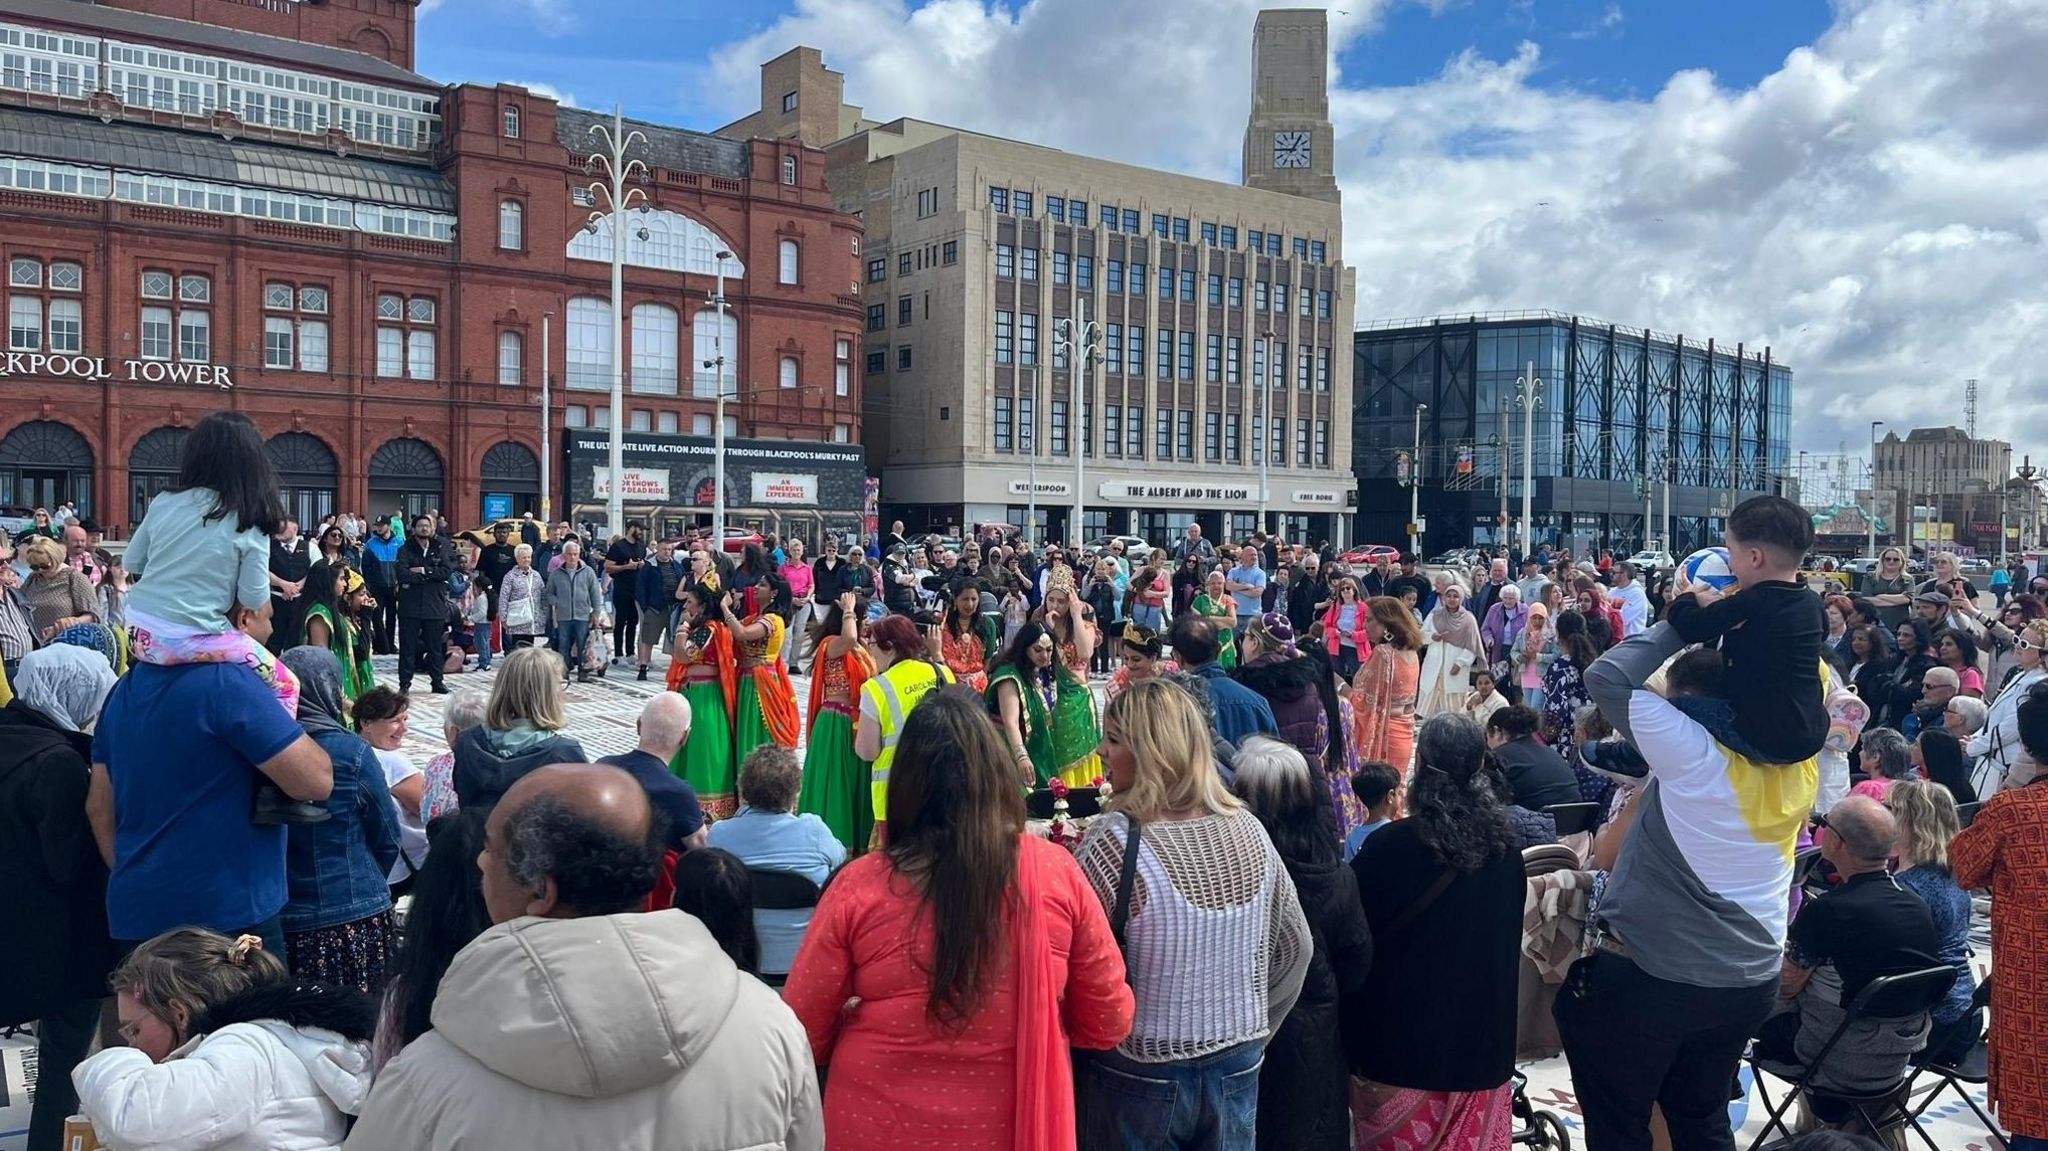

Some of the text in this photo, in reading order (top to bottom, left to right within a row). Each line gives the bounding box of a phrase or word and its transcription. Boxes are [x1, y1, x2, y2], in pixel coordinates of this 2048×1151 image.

[0, 352, 233, 389] KPOOL TOWER
[578, 441, 860, 462] THE ULTATE LIVE ACTION JOURNY THROUGH BLACKPOOL'S MURKY PAST
[1015, 484, 1066, 492] WETERSPOON
[1127, 486, 1248, 499] THE ALBERT AND THE LION
[765, 491, 805, 499] EXPERIENCE
